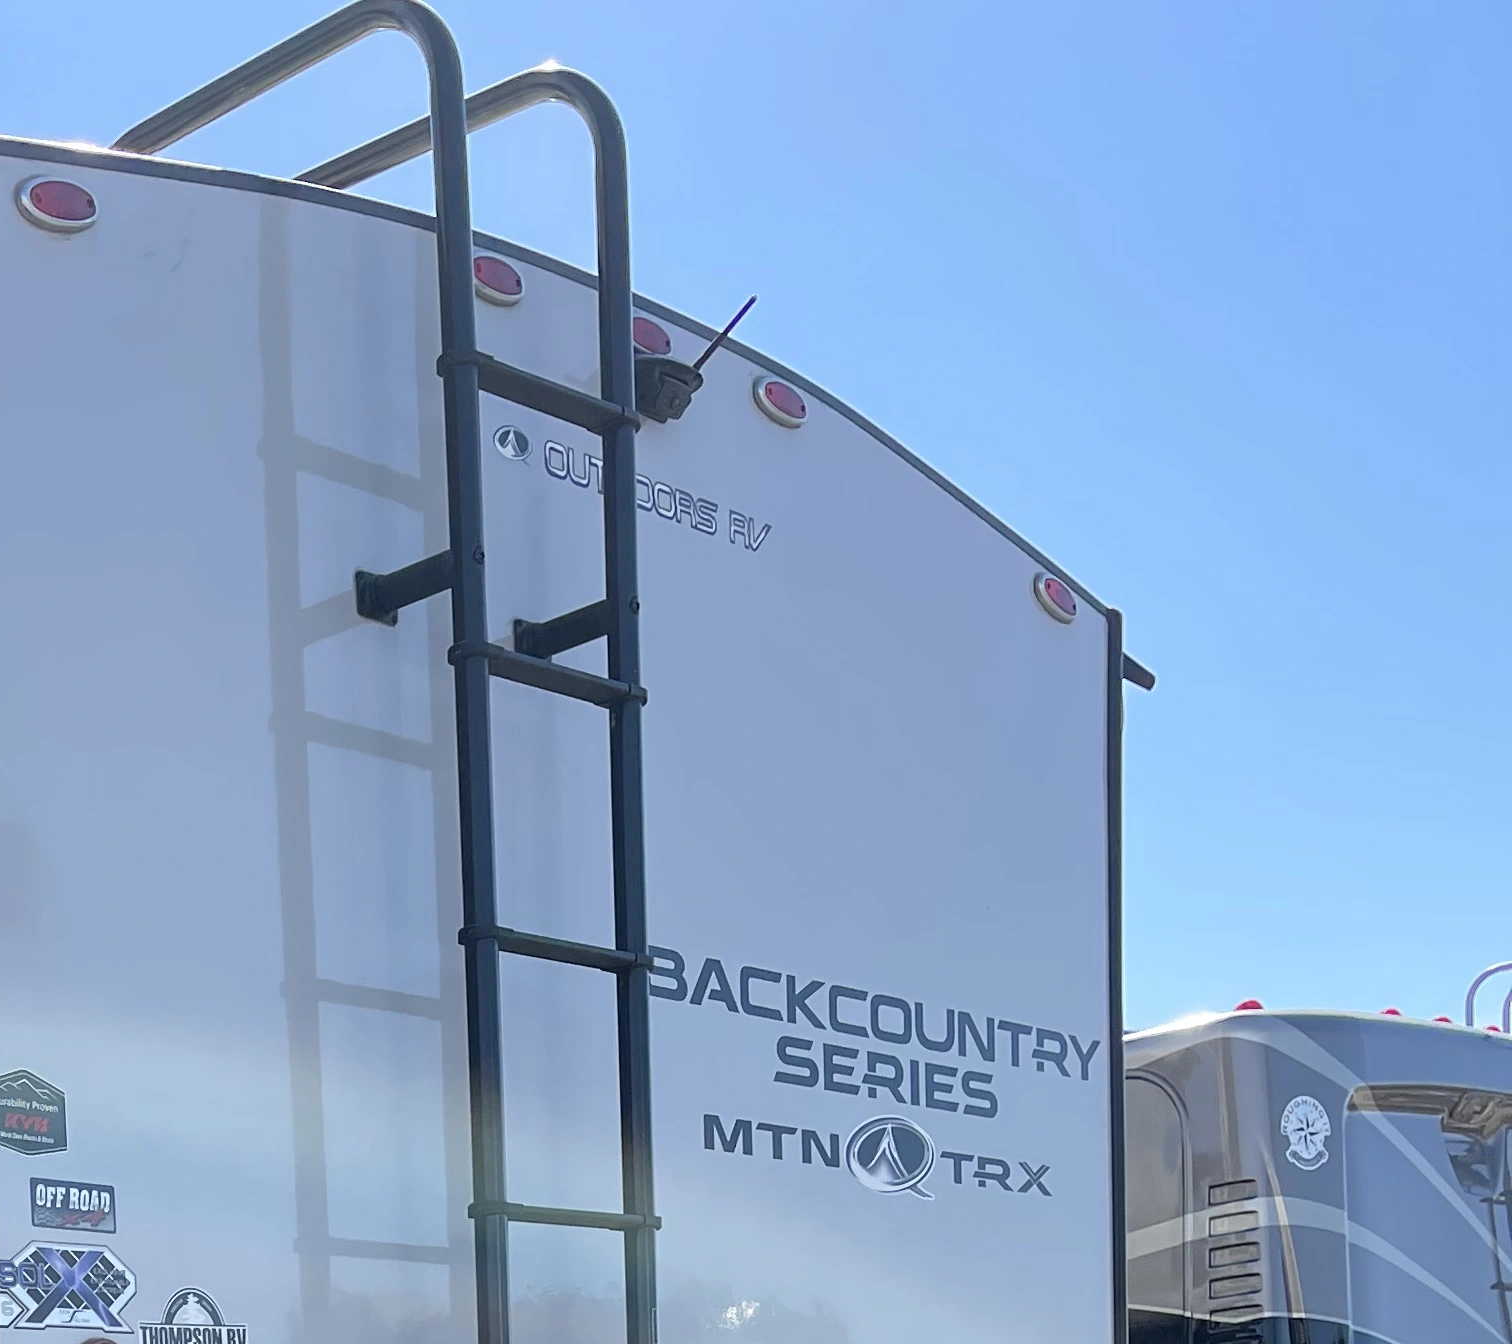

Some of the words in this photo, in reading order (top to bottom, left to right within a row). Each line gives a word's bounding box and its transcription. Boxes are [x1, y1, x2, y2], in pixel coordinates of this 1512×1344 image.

[544, 440, 718, 535] OUTOORS
[729, 509, 771, 552] RV
[648, 944, 1100, 1081] BACKCOUNTRY
[32, 1100, 59, 1113] Proven
[773, 1035, 998, 1119] SERIES
[1282, 1098, 1326, 1134] ROUGHING
[703, 1113, 841, 1169] MTN
[940, 1150, 1052, 1197] TRX
[35, 1183, 67, 1208] OFF
[68, 1187, 111, 1213] ROAD
